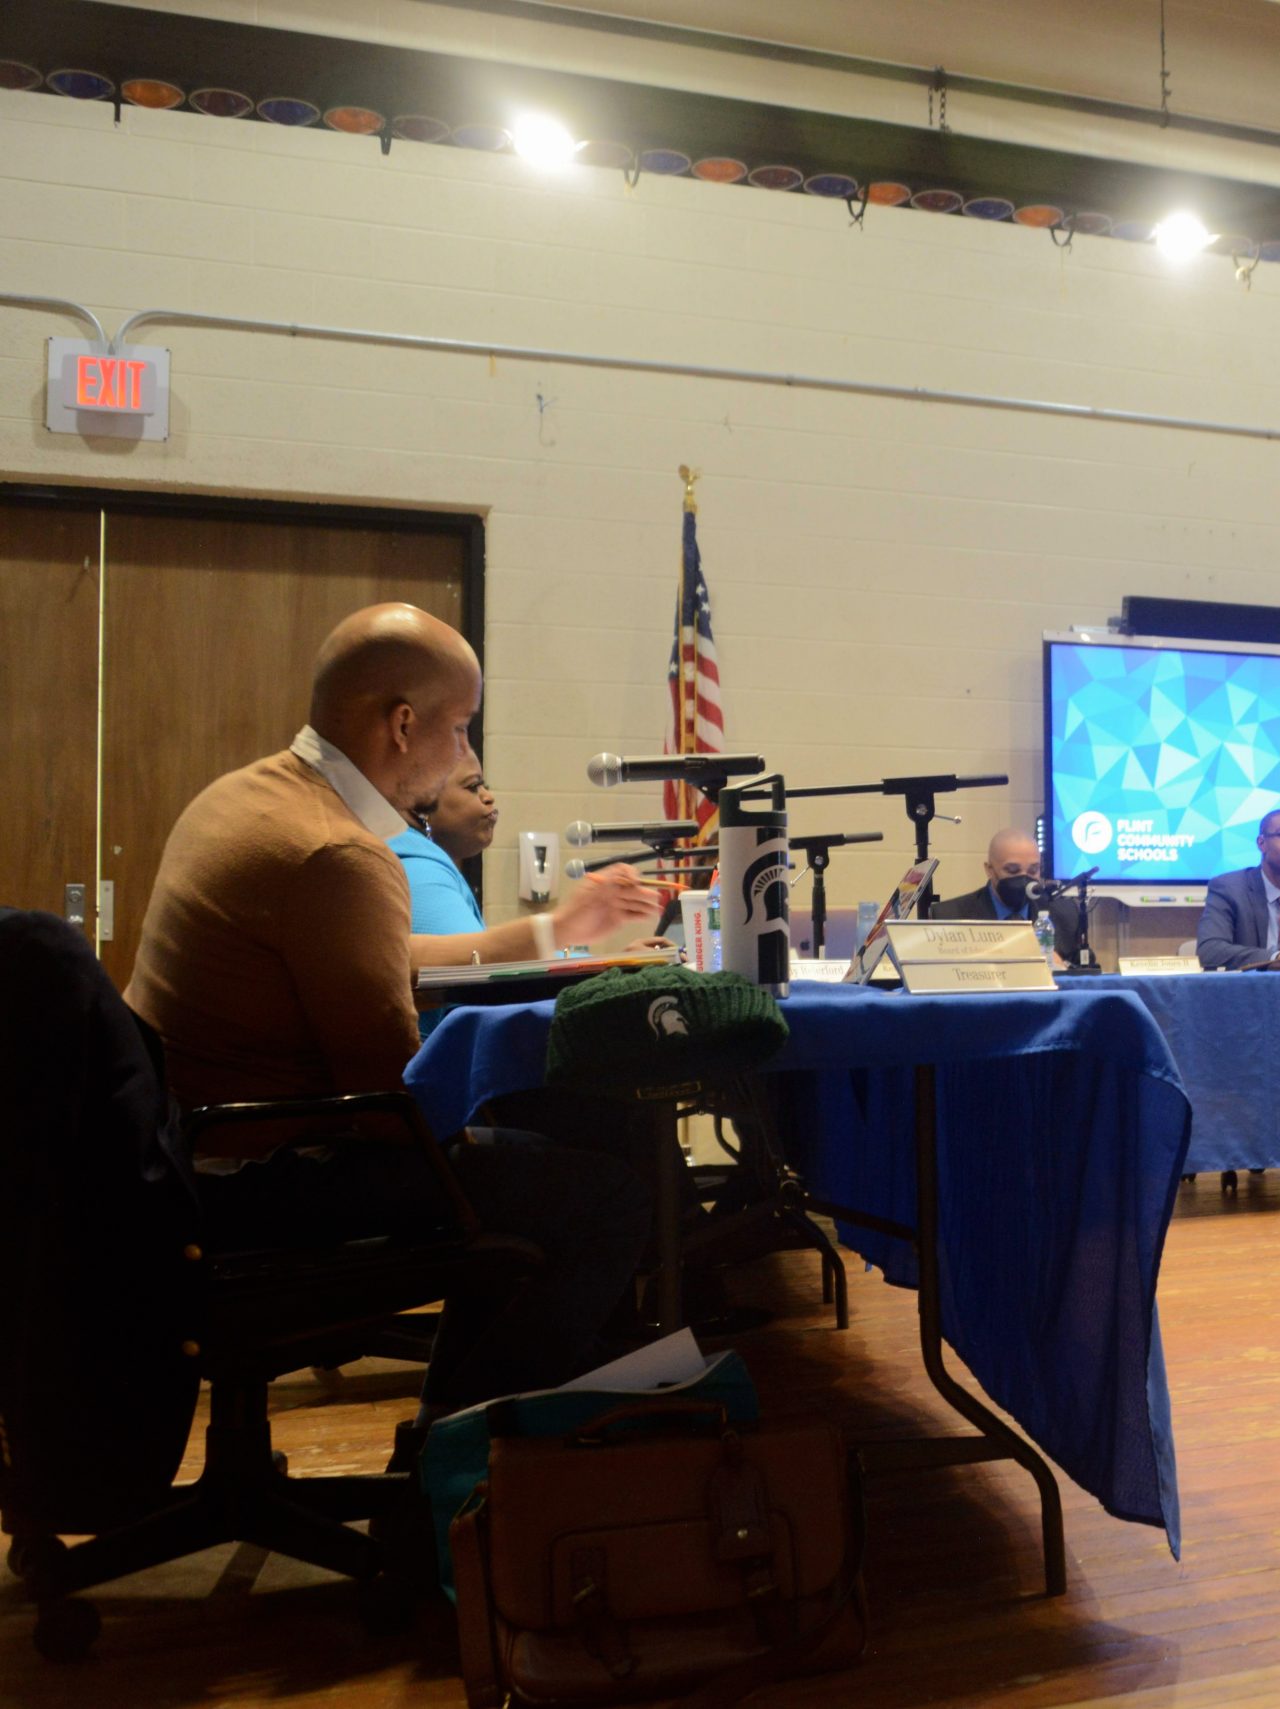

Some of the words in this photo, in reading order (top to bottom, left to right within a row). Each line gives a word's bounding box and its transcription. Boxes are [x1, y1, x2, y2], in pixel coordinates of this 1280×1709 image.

[78, 355, 147, 410] EXIT
[1116, 819, 1153, 833] FLINT
[1116, 833, 1195, 848] COMMUNITY
[1117, 847, 1178, 861] SCHOOLS
[693, 912, 702, 934] KING
[922, 927, 967, 946] Dylan
[970, 927, 1006, 943] Luna
[953, 967, 1008, 982] Treasurer
